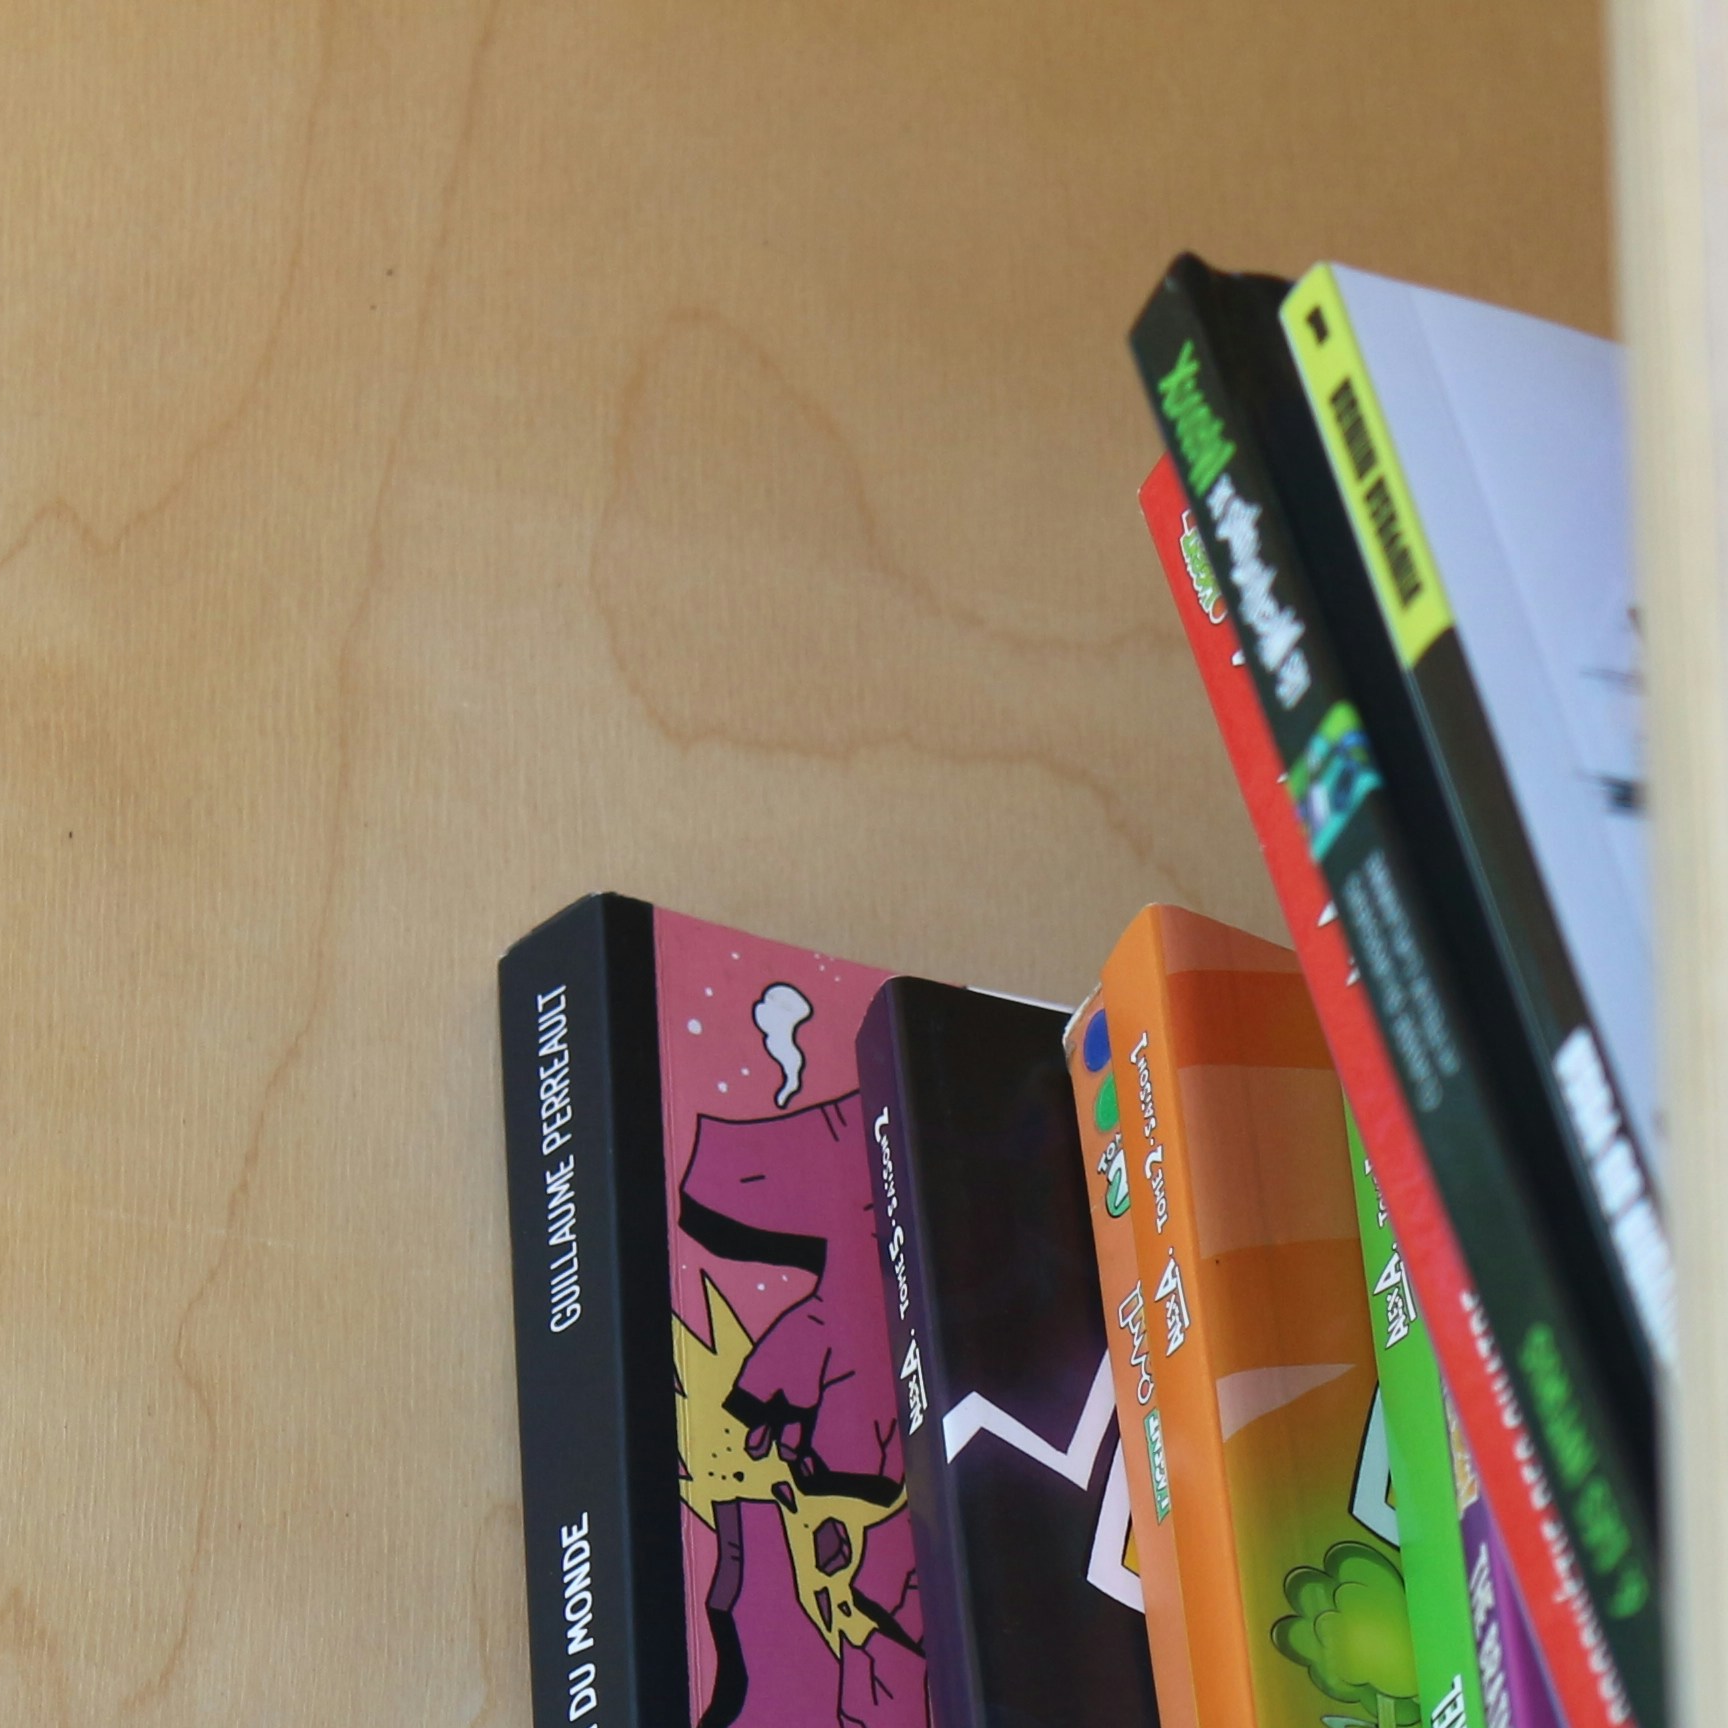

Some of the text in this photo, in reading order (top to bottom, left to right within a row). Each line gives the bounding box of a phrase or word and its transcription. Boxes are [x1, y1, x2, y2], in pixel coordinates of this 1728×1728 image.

[538, 986, 583, 1334] GUILLAUME PERREAULT
[562, 1512, 595, 1656] MONDE
[569, 1664, 599, 1723] DU
